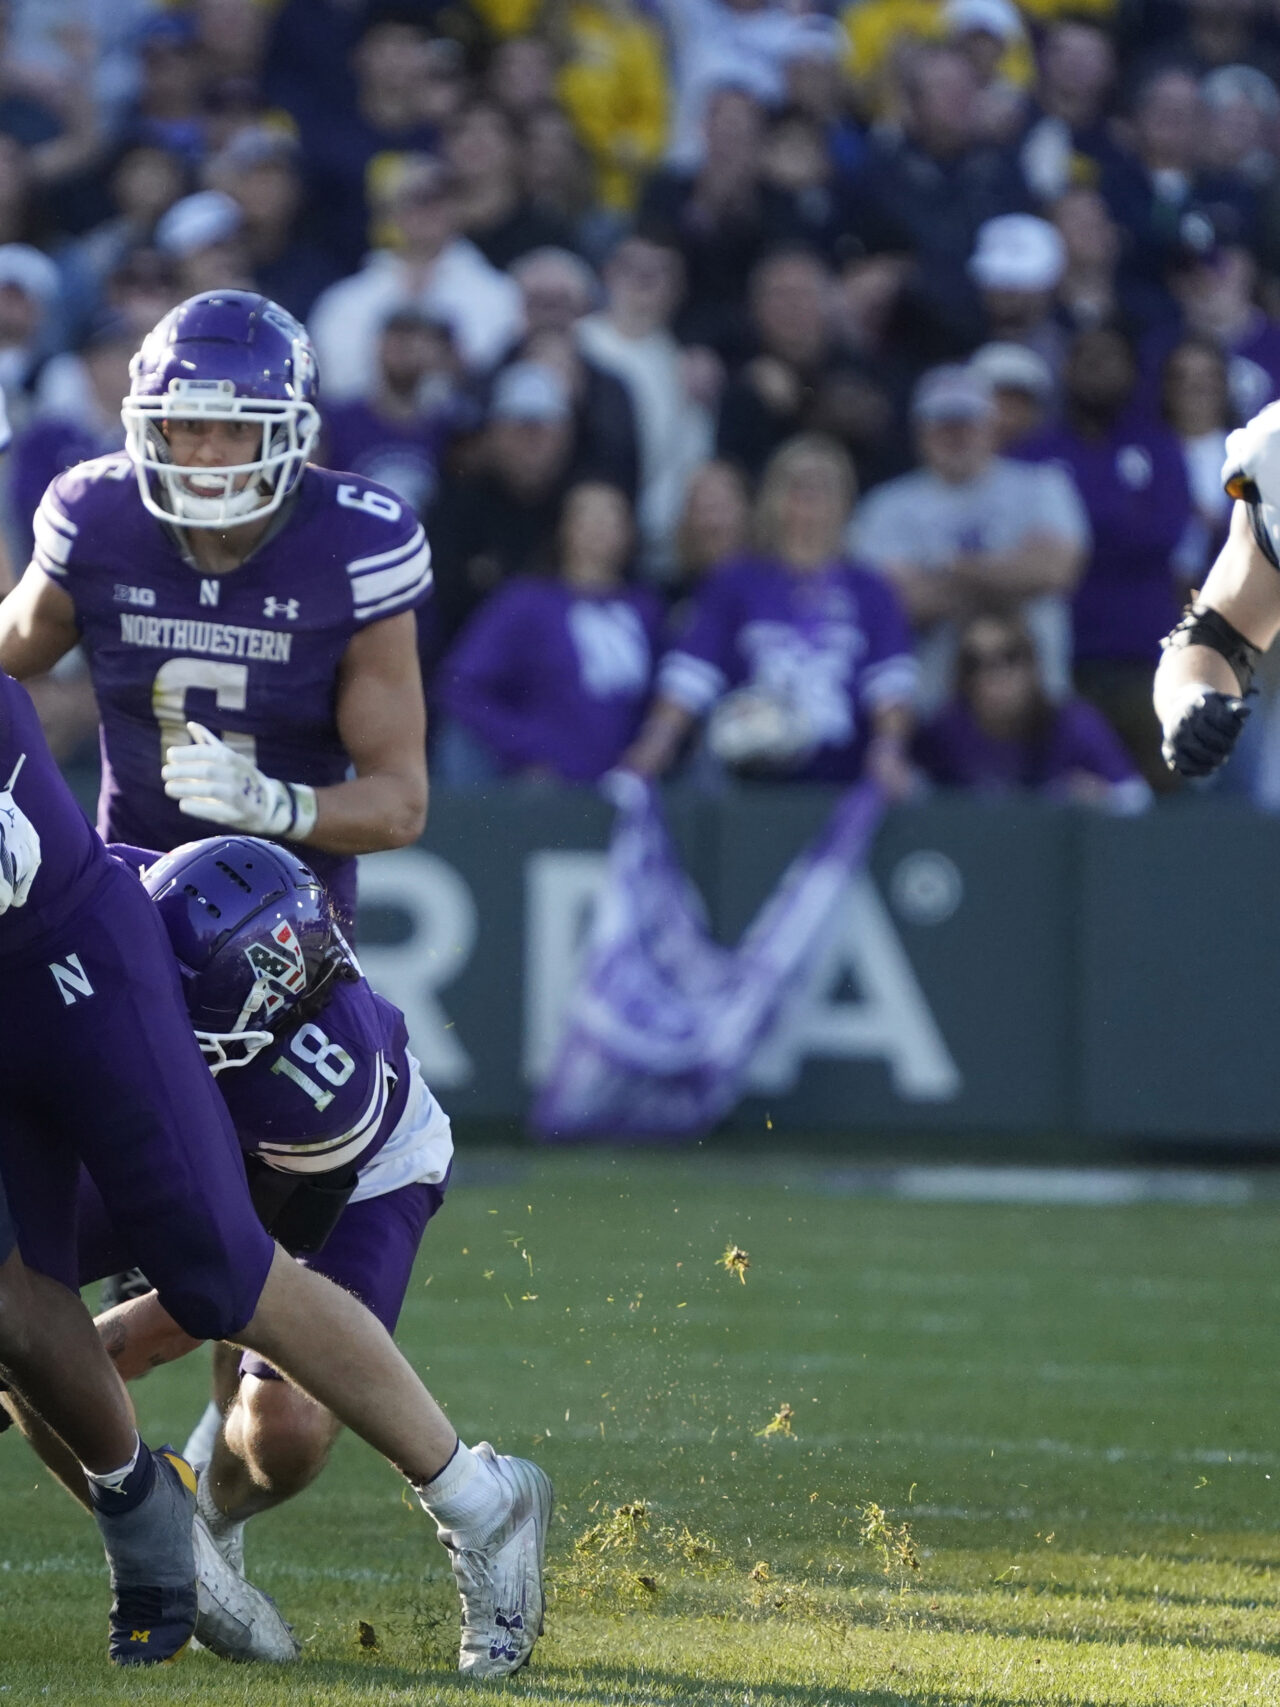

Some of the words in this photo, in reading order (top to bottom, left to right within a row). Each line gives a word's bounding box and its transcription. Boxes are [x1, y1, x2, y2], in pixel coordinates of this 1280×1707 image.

[336, 483, 402, 522] 6
[199, 579, 220, 607] N
[120, 613, 293, 664] NORTHWESTERN
[47, 952, 95, 1006] N
[271, 1022, 356, 1113] 18
[130, 1630, 151, 1643] M
